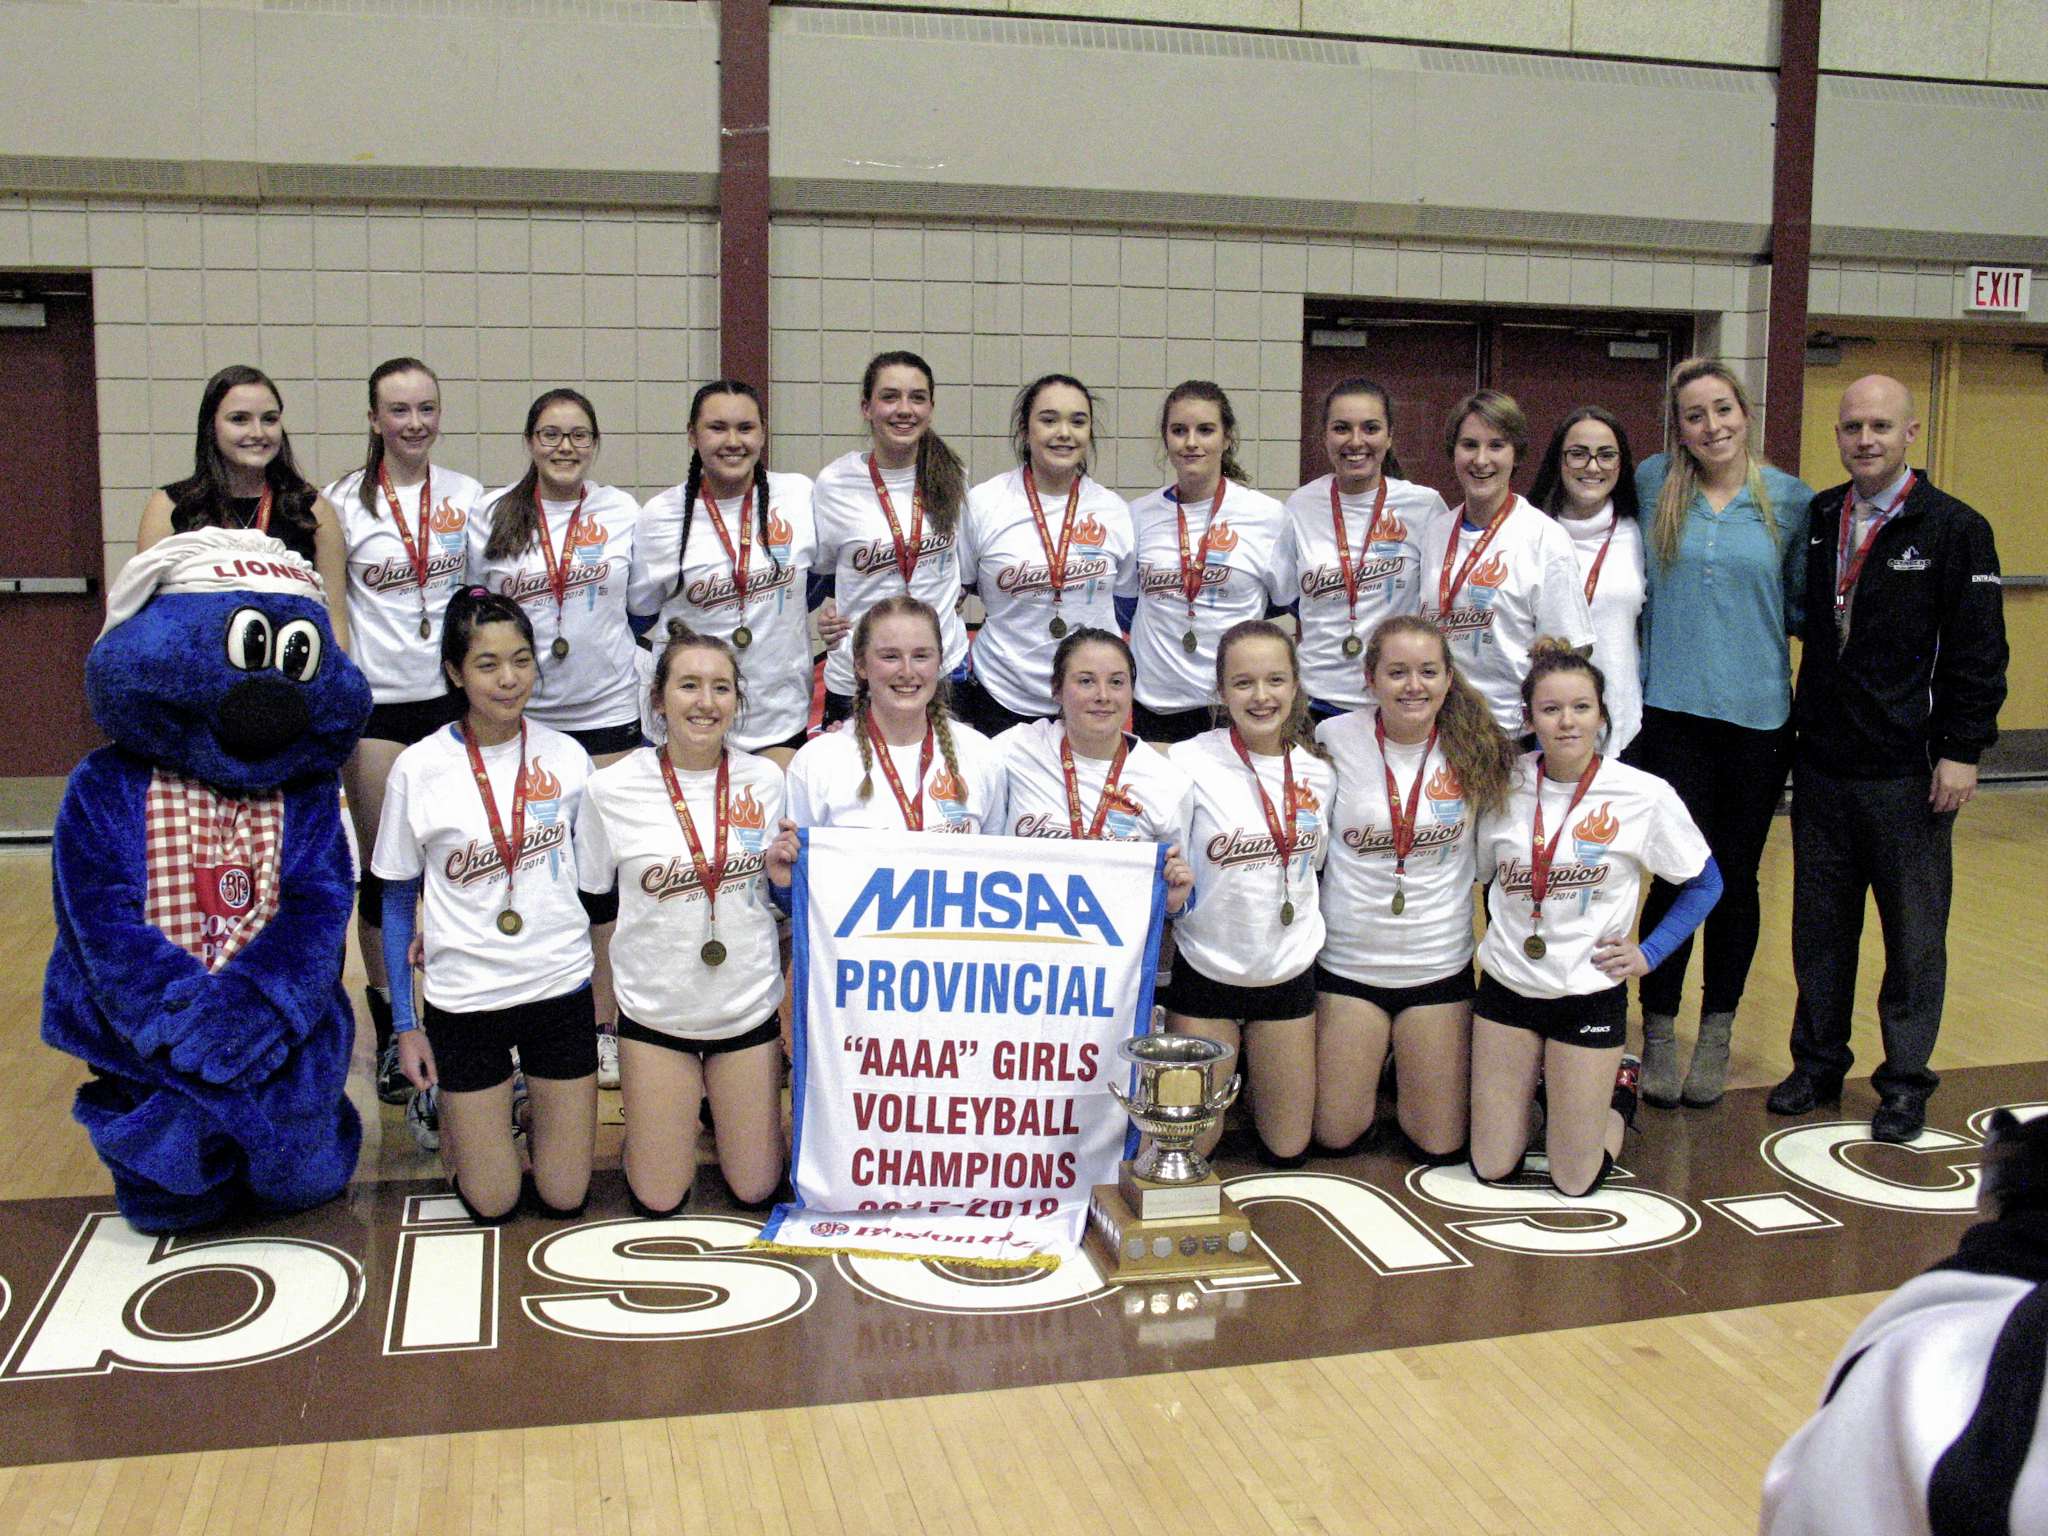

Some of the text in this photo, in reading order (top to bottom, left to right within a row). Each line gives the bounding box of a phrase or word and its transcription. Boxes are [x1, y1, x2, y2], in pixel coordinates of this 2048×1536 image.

[1976, 271, 2024, 308] EXIT
[523, 855, 546, 870] 2018
[722, 882, 746, 894] 2018
[834, 867, 1124, 946] MHSAA
[1554, 892, 1577, 900] 2018
[836, 959, 1114, 1017] PROVINCIAL
[993, 1041, 1100, 1082] GIRLS
[853, 1092, 1080, 1135] VOLLEYBALL
[851, 1147, 1077, 1189] CHAMPIONS
